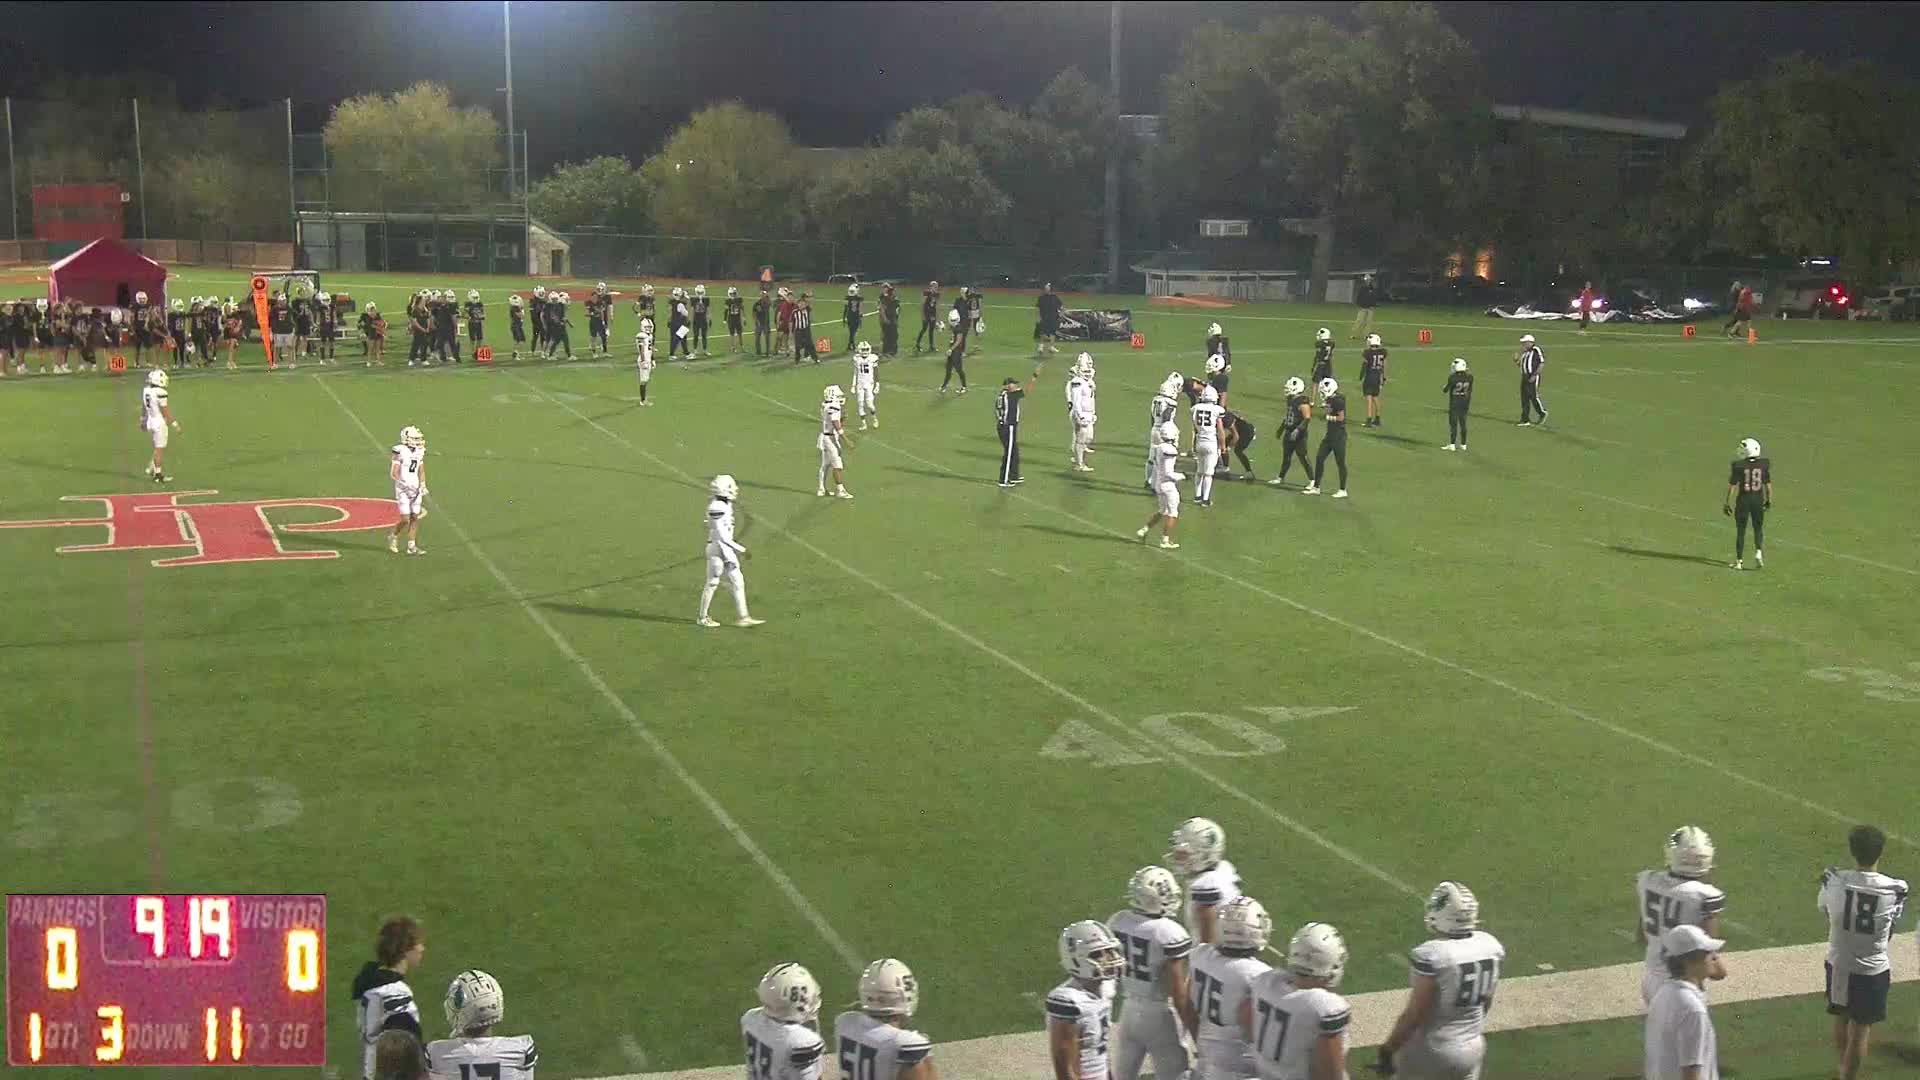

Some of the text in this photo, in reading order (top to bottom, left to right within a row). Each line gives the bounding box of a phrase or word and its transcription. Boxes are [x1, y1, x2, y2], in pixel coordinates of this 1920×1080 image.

[1743, 468, 1762, 492] 18
[1842, 889, 1878, 935] 18
[1194, 967, 1224, 1027] 76
[1257, 998, 1291, 1062] 77
